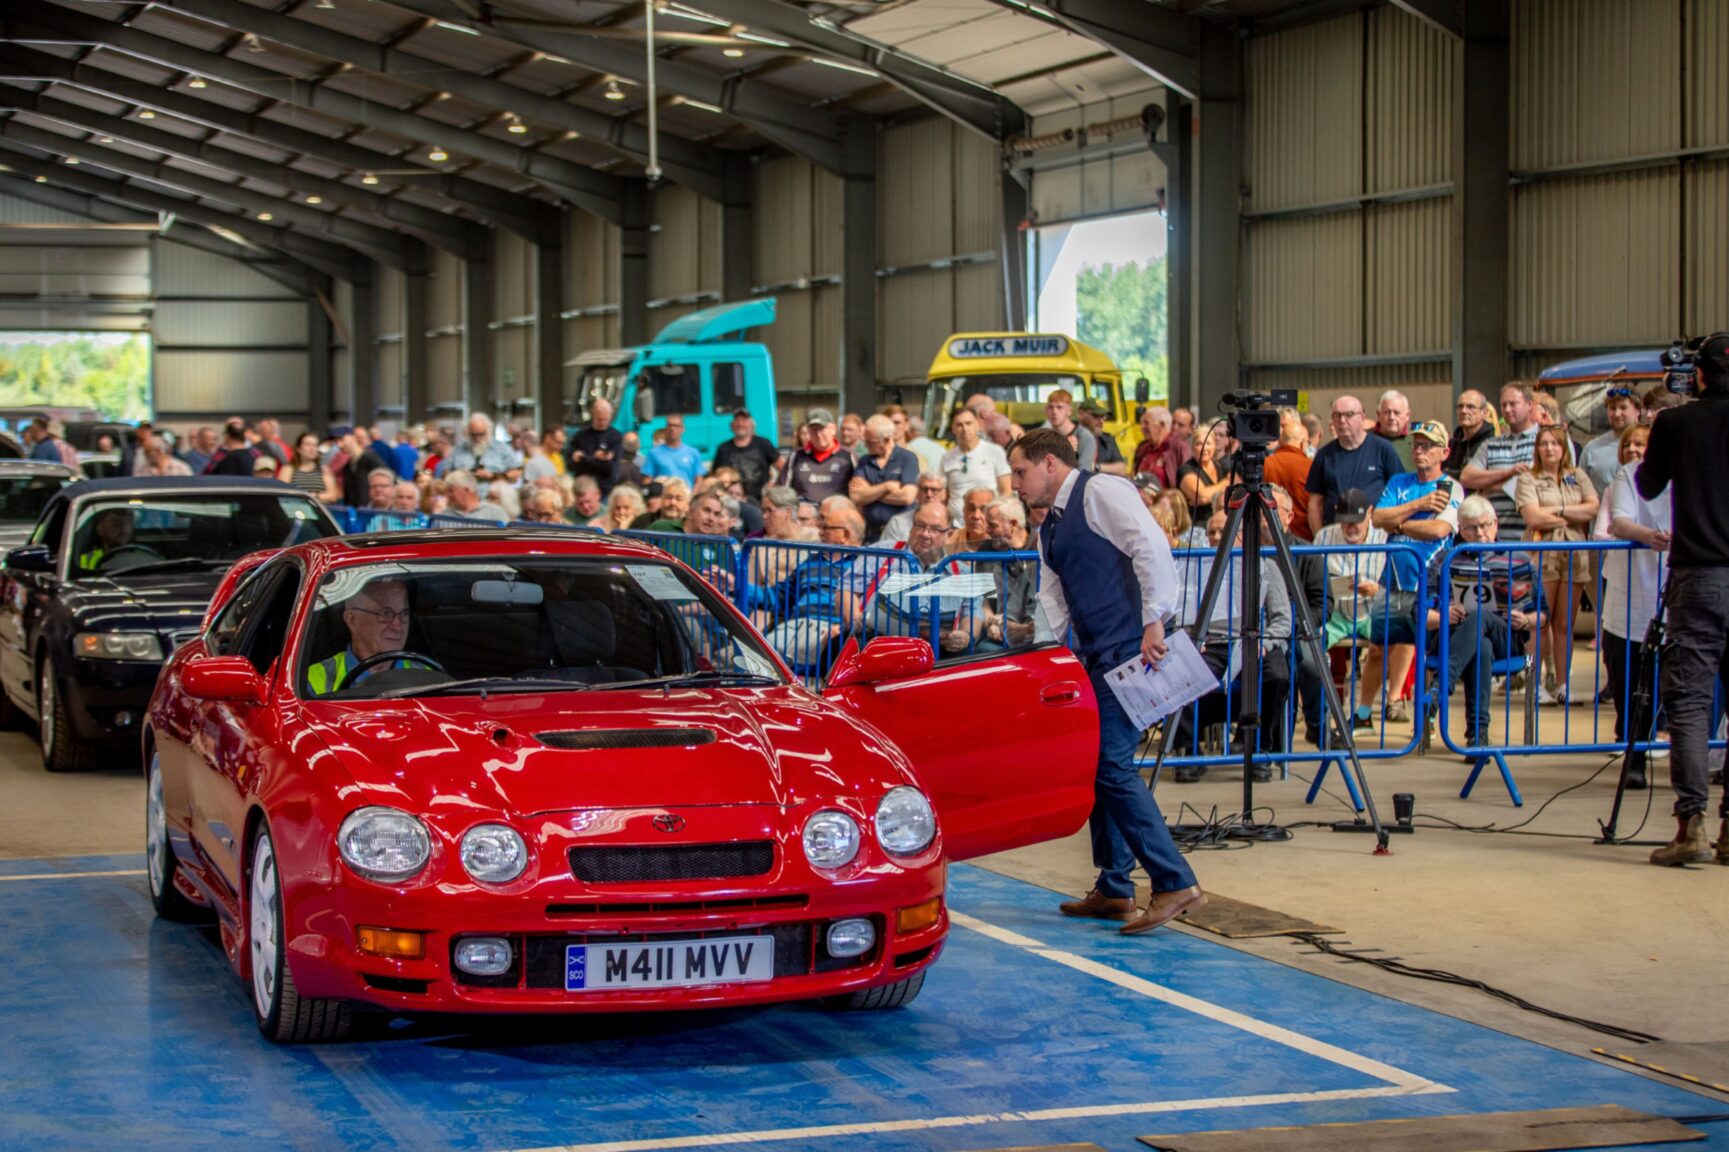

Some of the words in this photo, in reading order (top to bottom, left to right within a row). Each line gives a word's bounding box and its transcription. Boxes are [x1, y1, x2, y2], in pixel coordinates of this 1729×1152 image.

[959, 340, 1005, 354] JACK
[1013, 338, 1060, 352] MUIR
[1454, 583, 1492, 604] 79
[685, 943, 754, 978] MVV
[568, 970, 584, 980] SCO
